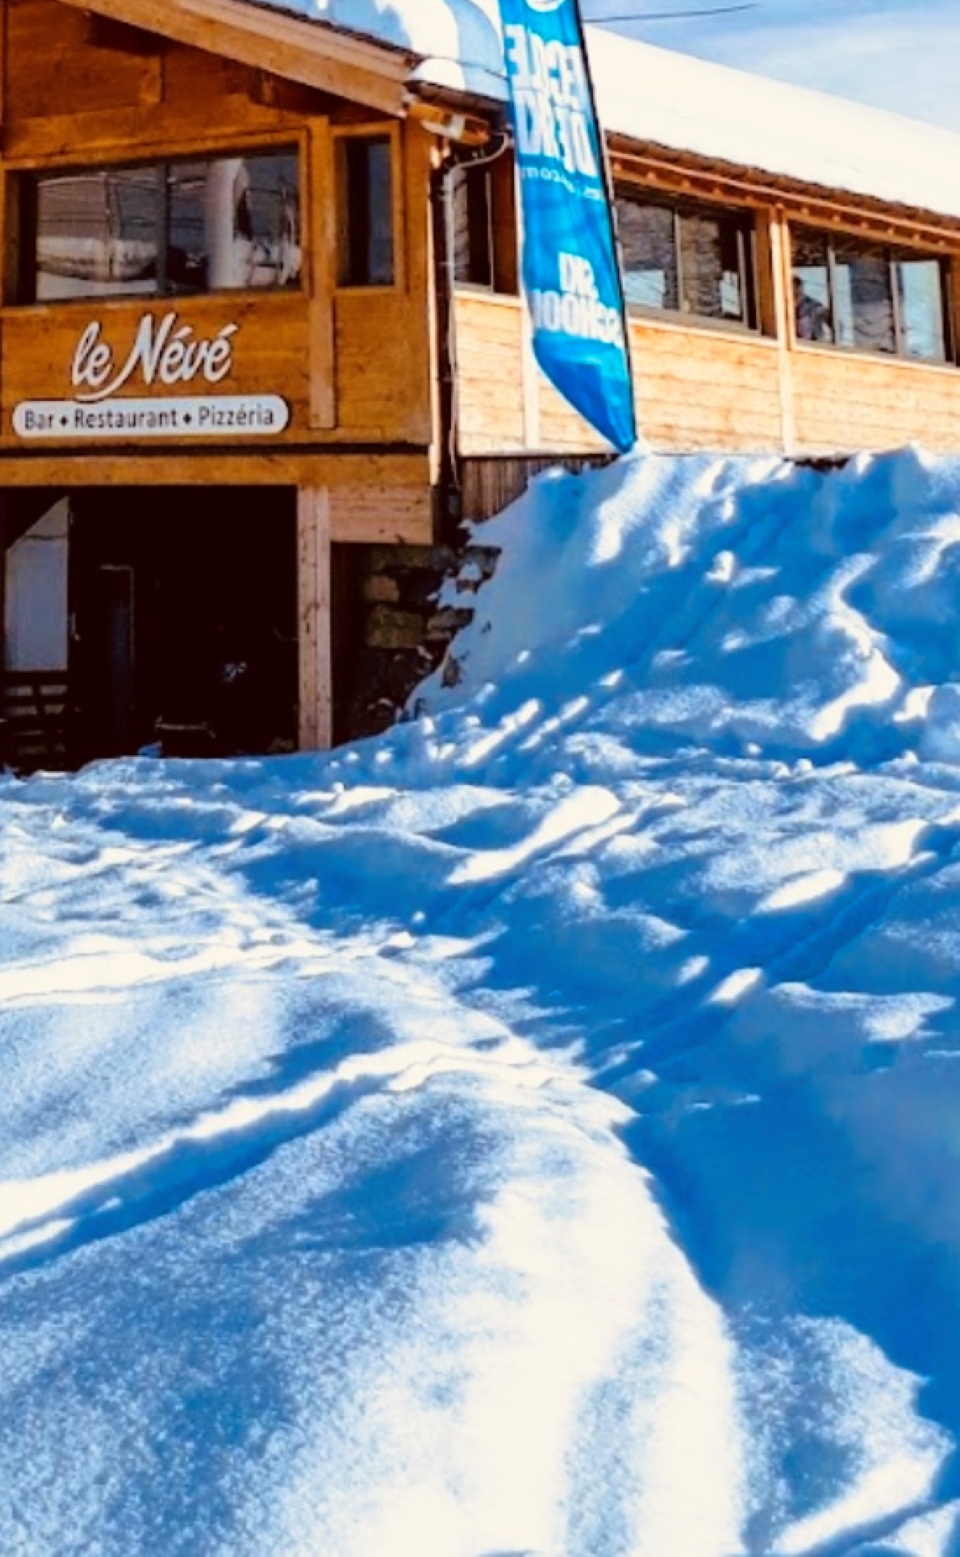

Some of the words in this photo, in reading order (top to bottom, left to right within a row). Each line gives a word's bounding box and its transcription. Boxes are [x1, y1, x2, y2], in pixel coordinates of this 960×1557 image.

[70, 321, 112, 386] le
[75, 312, 238, 402] Névé
[23, 407, 54, 430] Bar
[73, 406, 178, 429] Restaurant
[197, 403, 275, 427] Pizzéria
